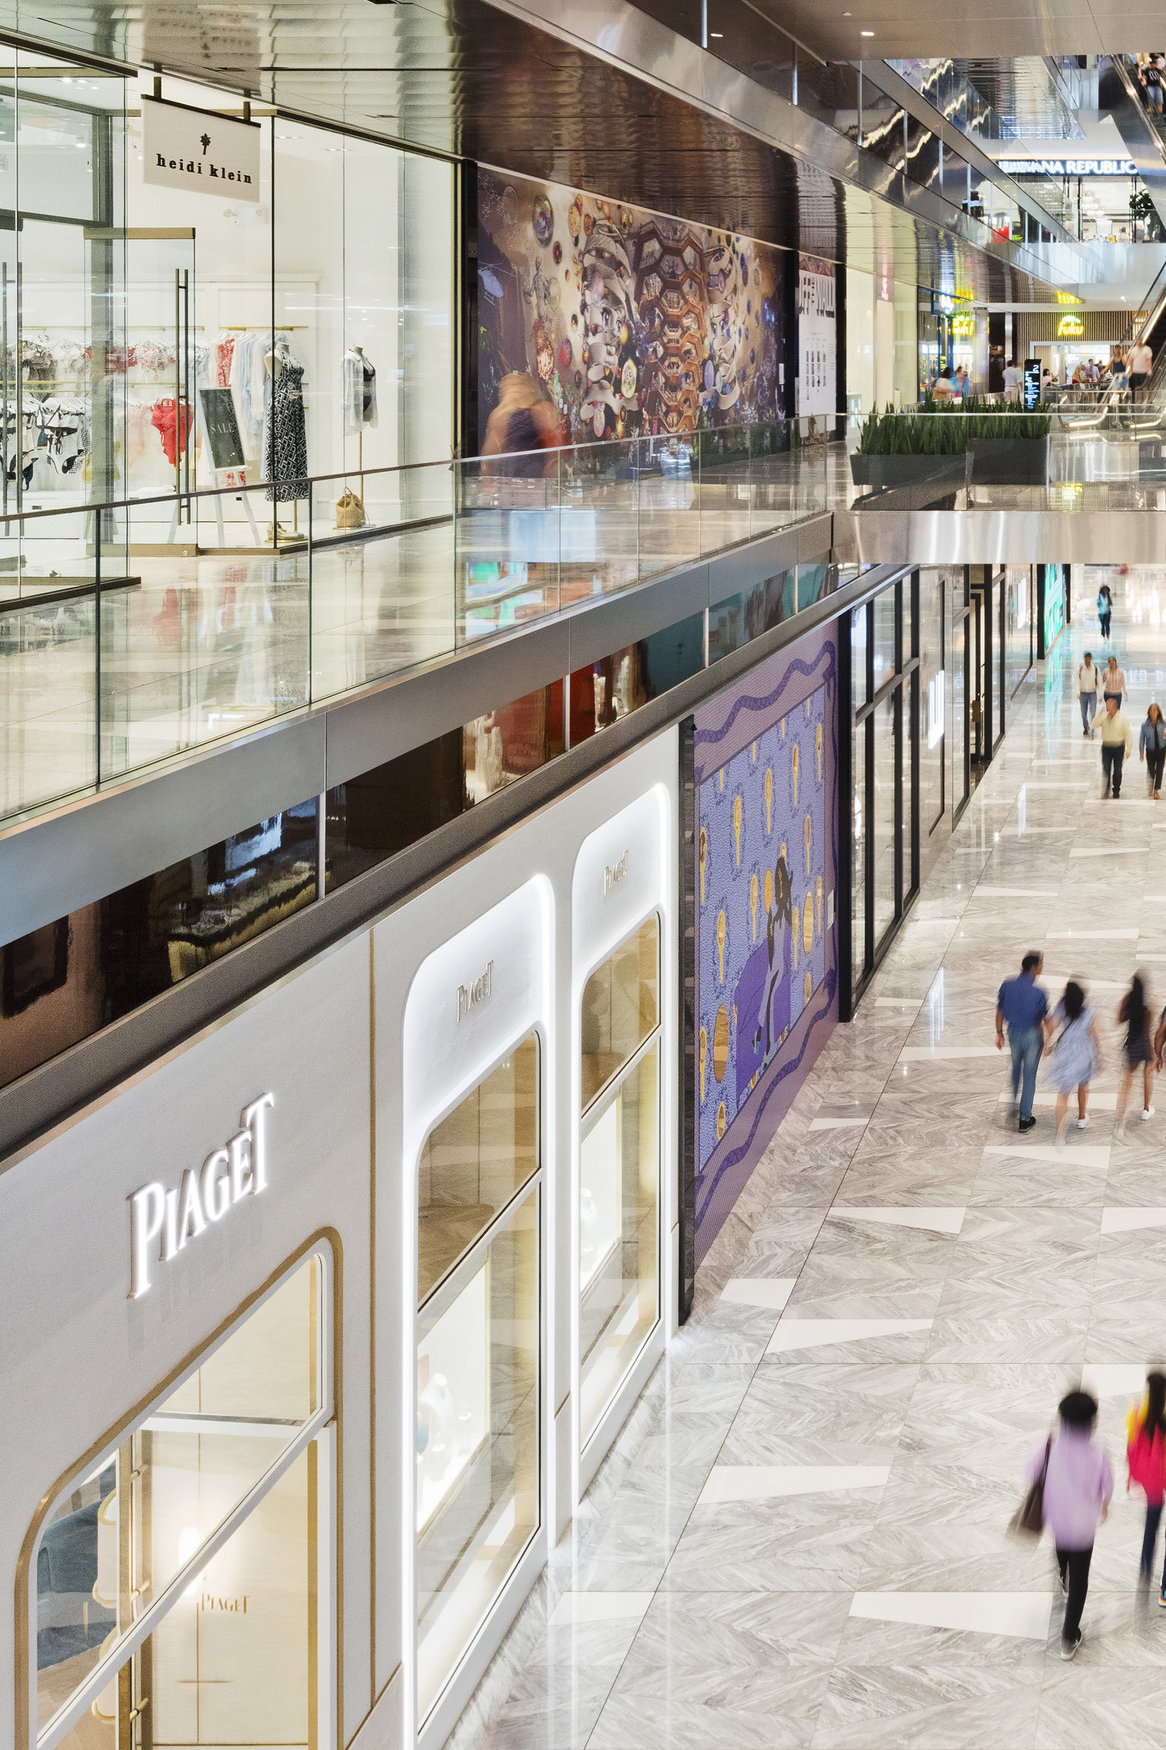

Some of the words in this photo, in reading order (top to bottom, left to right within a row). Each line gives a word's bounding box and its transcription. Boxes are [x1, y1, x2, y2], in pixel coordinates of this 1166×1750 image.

[156, 152, 202, 175] heidi
[209, 163, 252, 184] klein
[1066, 160, 1138, 174] REPUBLIC
[1057, 319, 1085, 337] fuku
[210, 422, 235, 434] SALE
[603, 849, 629, 896] PIAGET
[456, 959, 495, 1024] PIAGET
[125, 1091, 275, 1299] PIAGET
[201, 1593, 251, 1615] PIAGET
